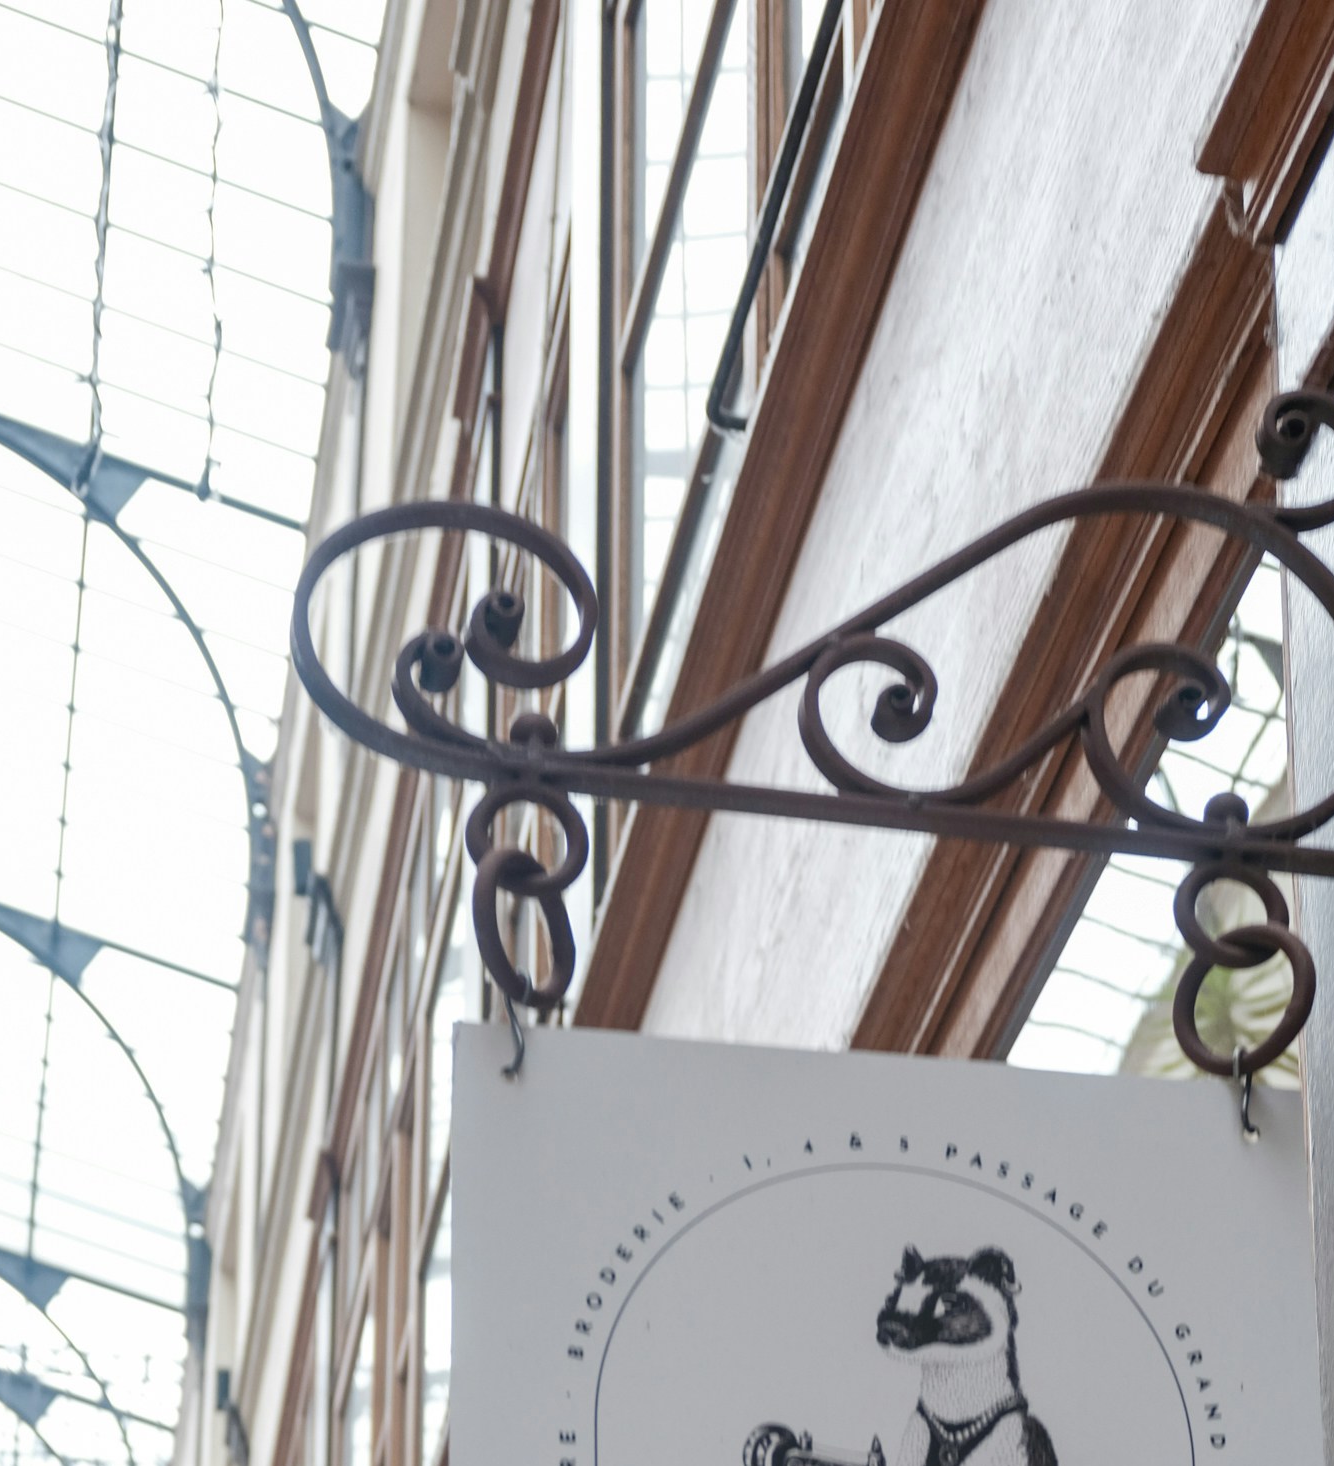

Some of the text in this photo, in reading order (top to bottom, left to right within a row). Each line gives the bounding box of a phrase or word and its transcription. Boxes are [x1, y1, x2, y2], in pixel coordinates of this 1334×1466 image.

[567, 1190, 685, 1361] BRODERIE
[945, 1142, 1108, 1239] PASSAGE
[1127, 1256, 1165, 1299] DU
[1174, 1322, 1227, 1450] GRAND
